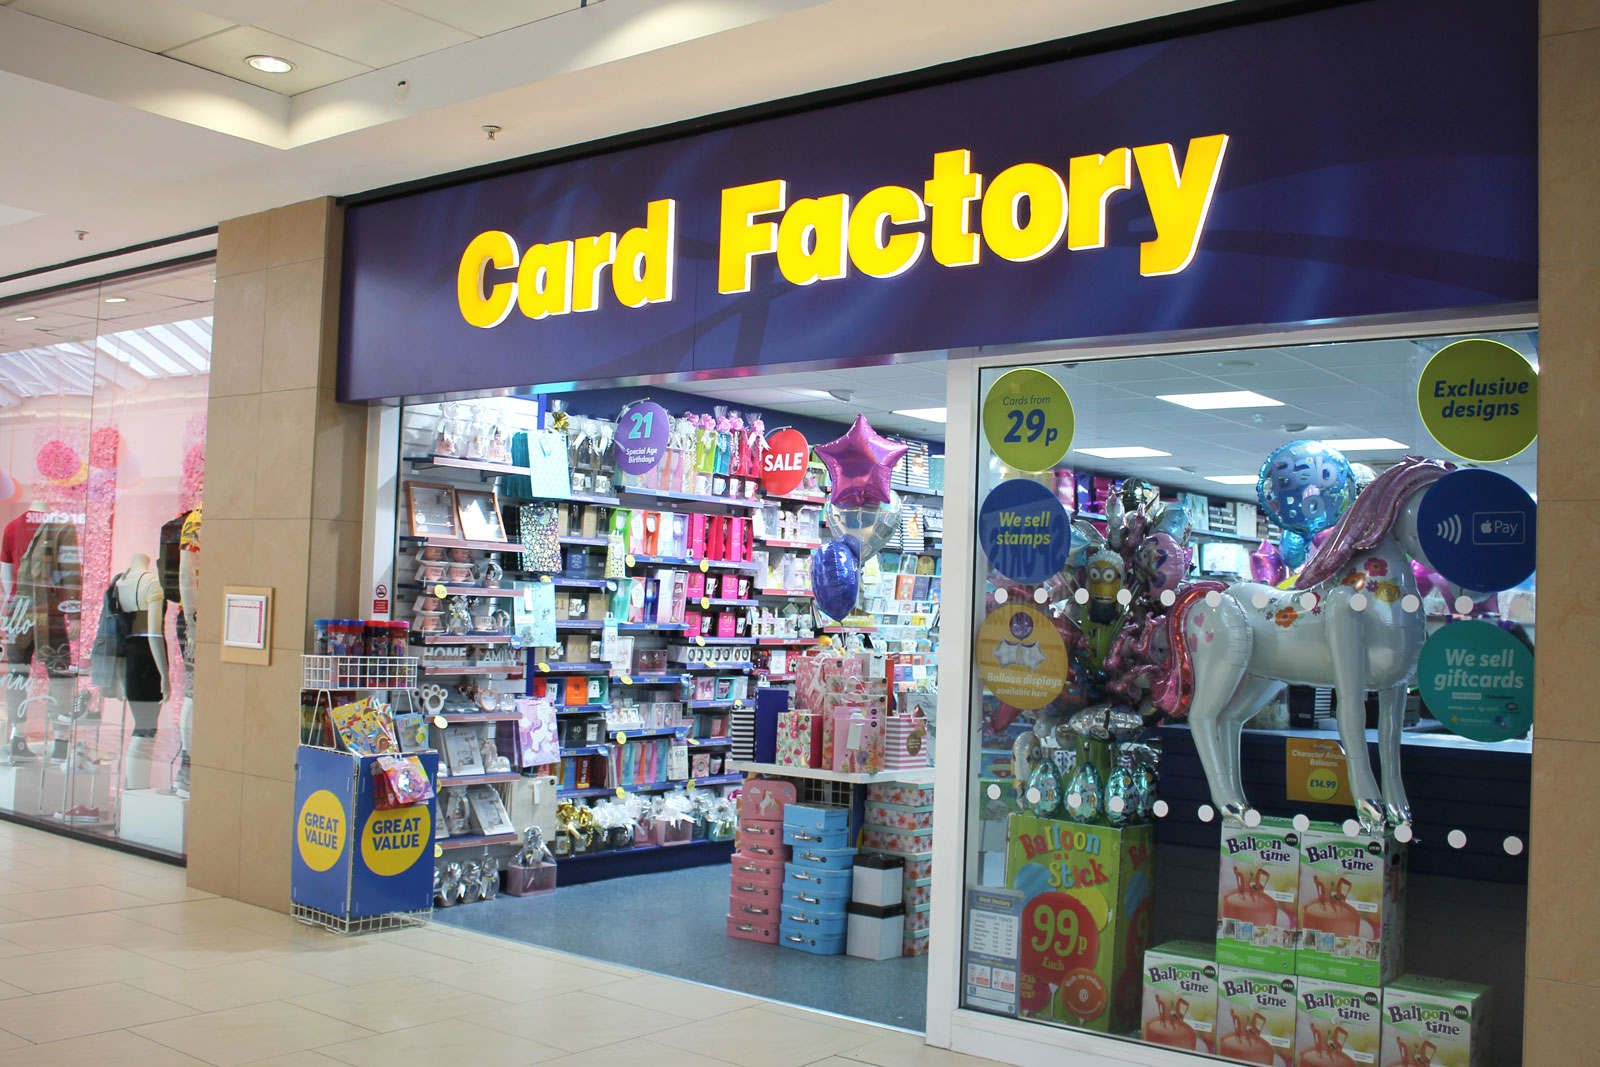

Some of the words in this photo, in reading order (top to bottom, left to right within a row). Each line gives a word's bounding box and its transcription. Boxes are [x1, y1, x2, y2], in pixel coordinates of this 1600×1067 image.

[457, 198, 676, 329] Card
[717, 133, 1229, 295] Factory
[1434, 377, 1529, 398] Exclusive
[1002, 396, 1028, 406] Cards
[1030, 394, 1051, 405] from
[1441, 399, 1520, 421] designs
[628, 411, 654, 439] 21
[1003, 408, 1058, 446] 29p
[626, 447, 646, 457] Special
[646, 446, 658, 457] Age
[628, 455, 655, 464] Birthdays
[763, 452, 803, 472] SALE
[999, 511, 1021, 527] We
[1024, 511, 1051, 527] sell
[1494, 520, 1518, 536] Pay
[996, 530, 1051, 549] stamps
[0, 597, 36, 634] ello
[424, 647, 467, 658] HOME
[1445, 649, 1475, 667] We
[1479, 649, 1514, 668] sell
[700, 679, 712, 693] 16
[987, 672, 1022, 685] Balloon
[1023, 674, 1063, 688] displays
[1434, 668, 1525, 691] giftcards
[996, 687, 1031, 697] available
[1031, 688, 1048, 698] here
[1291, 749, 1323, 759] Character
[1309, 758, 1339, 767] Balloons
[1309, 779, 1337, 789] £14.99
[304, 811, 339, 834] GREAT
[372, 817, 421, 834] GREAT
[304, 828, 338, 850] VALUE
[372, 833, 420, 851] VALUE
[1018, 825, 1101, 860] Balloon
[1226, 836, 1281, 854] Balloon
[1260, 850, 1291, 862] time
[1306, 844, 1364, 863] Balloon
[1341, 858, 1374, 871] time
[1048, 859, 1109, 889] Stick
[1031, 904, 1088, 957] 99p
[1042, 956, 1065, 971] Each
[1148, 966, 1200, 983] Balloon
[1179, 980, 1209, 993] time
[1223, 980, 1278, 997] Balloon
[1256, 993, 1287, 1008] time
[1302, 992, 1361, 1010] Balloon
[1337, 1006, 1371, 1021] time
[1388, 1005, 1450, 1023] Balloon
[1425, 1020, 1460, 1035] time
